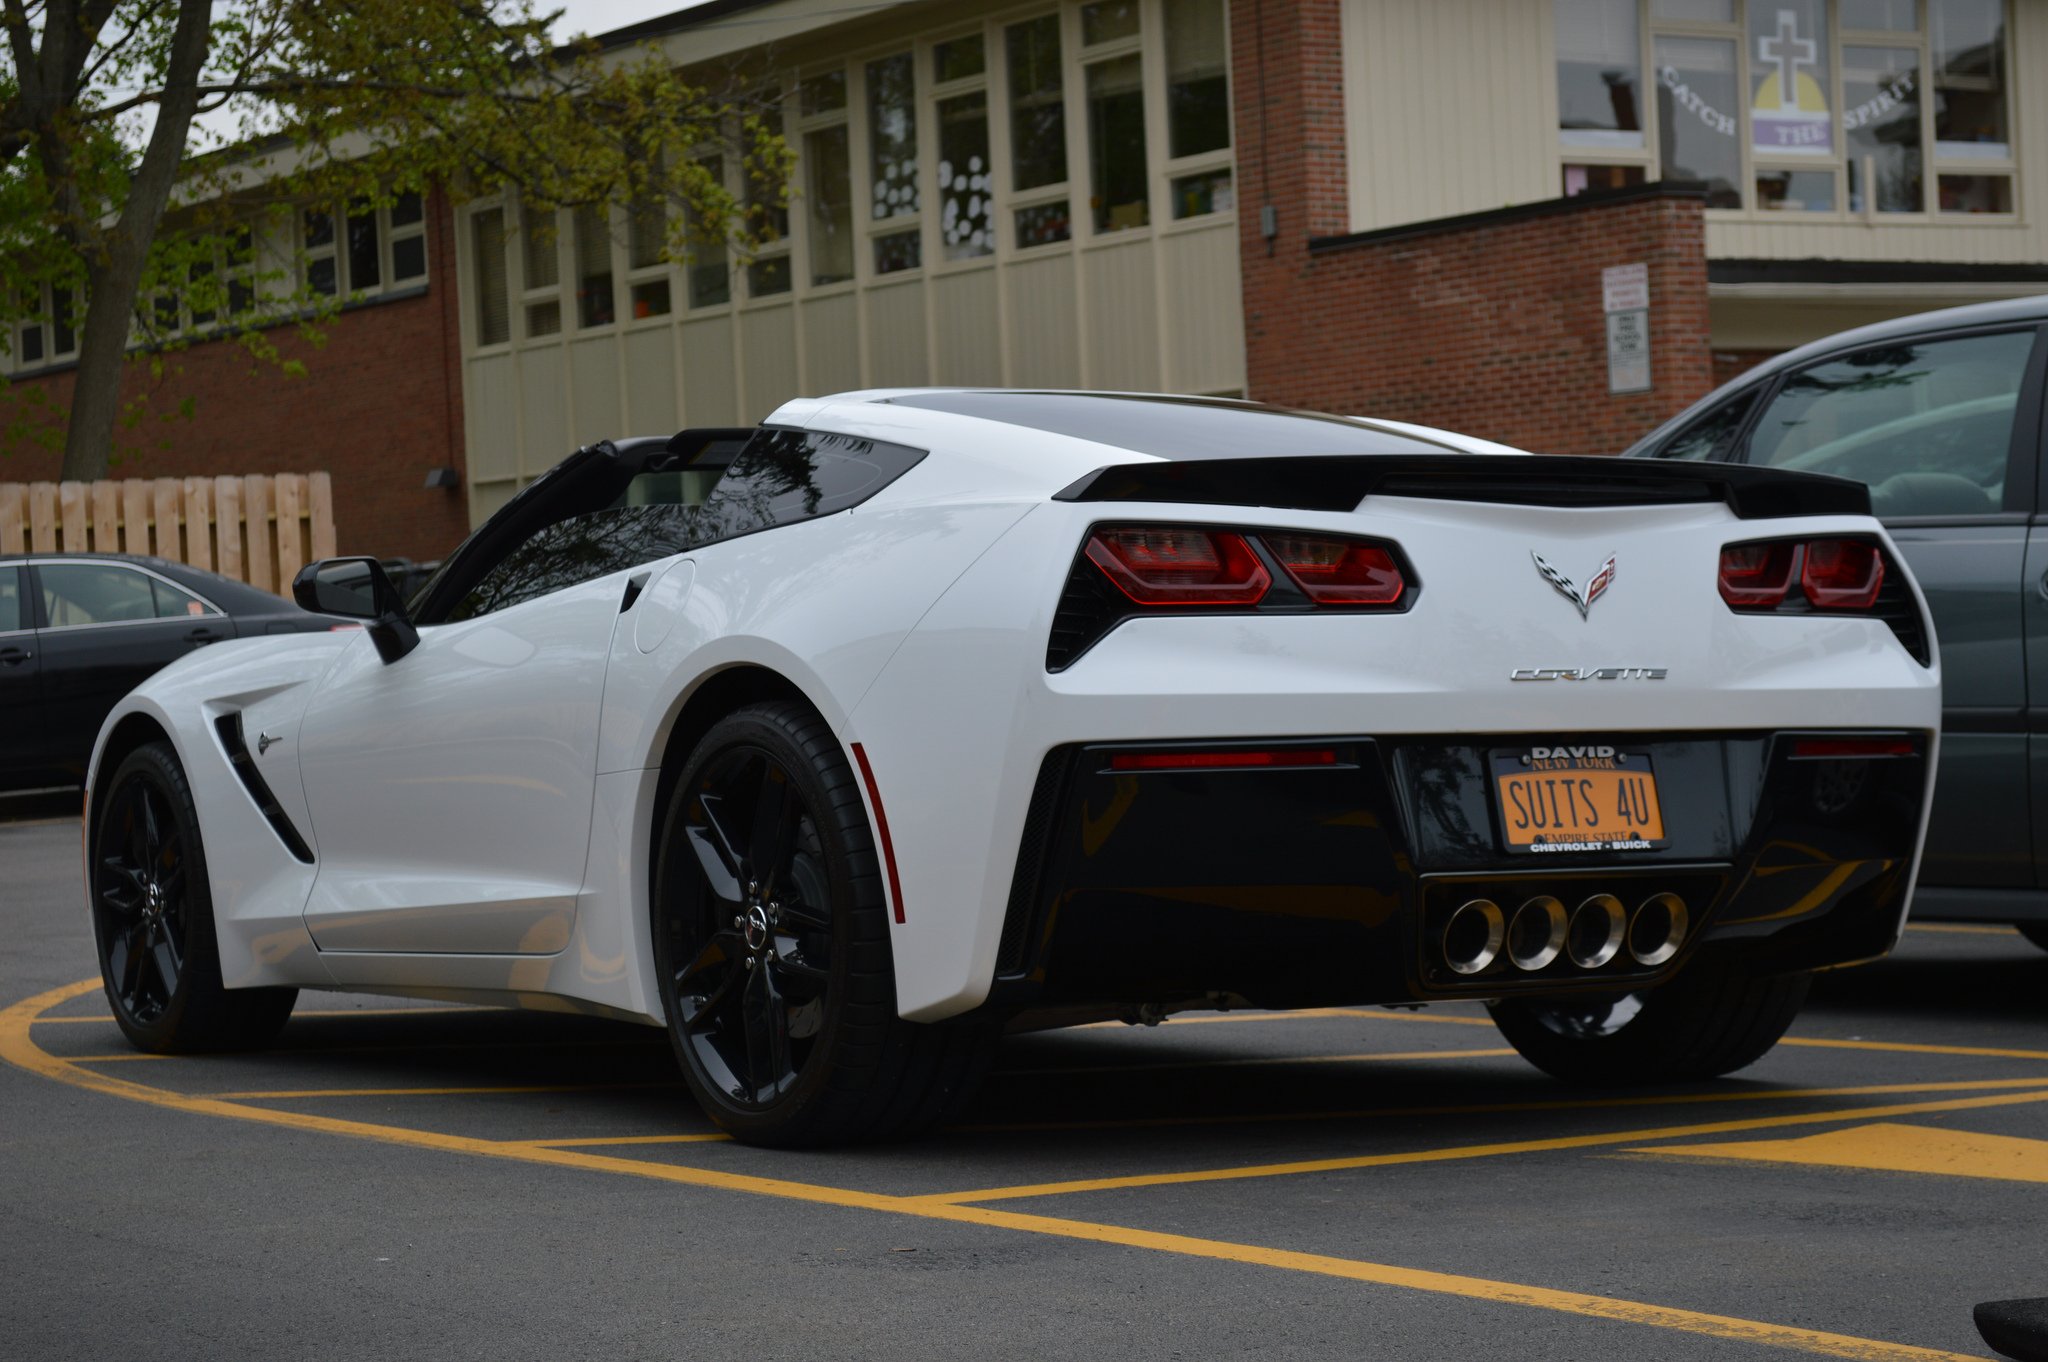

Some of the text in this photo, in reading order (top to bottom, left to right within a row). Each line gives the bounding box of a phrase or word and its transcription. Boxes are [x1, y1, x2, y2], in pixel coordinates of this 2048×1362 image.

[1661, 64, 1914, 144] CATCH THE SPIRIT
[1510, 668, 1668, 682] CORVETTE
[1531, 746, 1615, 759] DAVID
[1532, 757, 1616, 771] NEW YORK
[1509, 778, 1649, 829] SUITS 4U
[1544, 831, 1627, 844] EMPIRE STATE
[1530, 842, 1603, 853] CHEVROLET
[1612, 840, 1651, 851] BUICK
